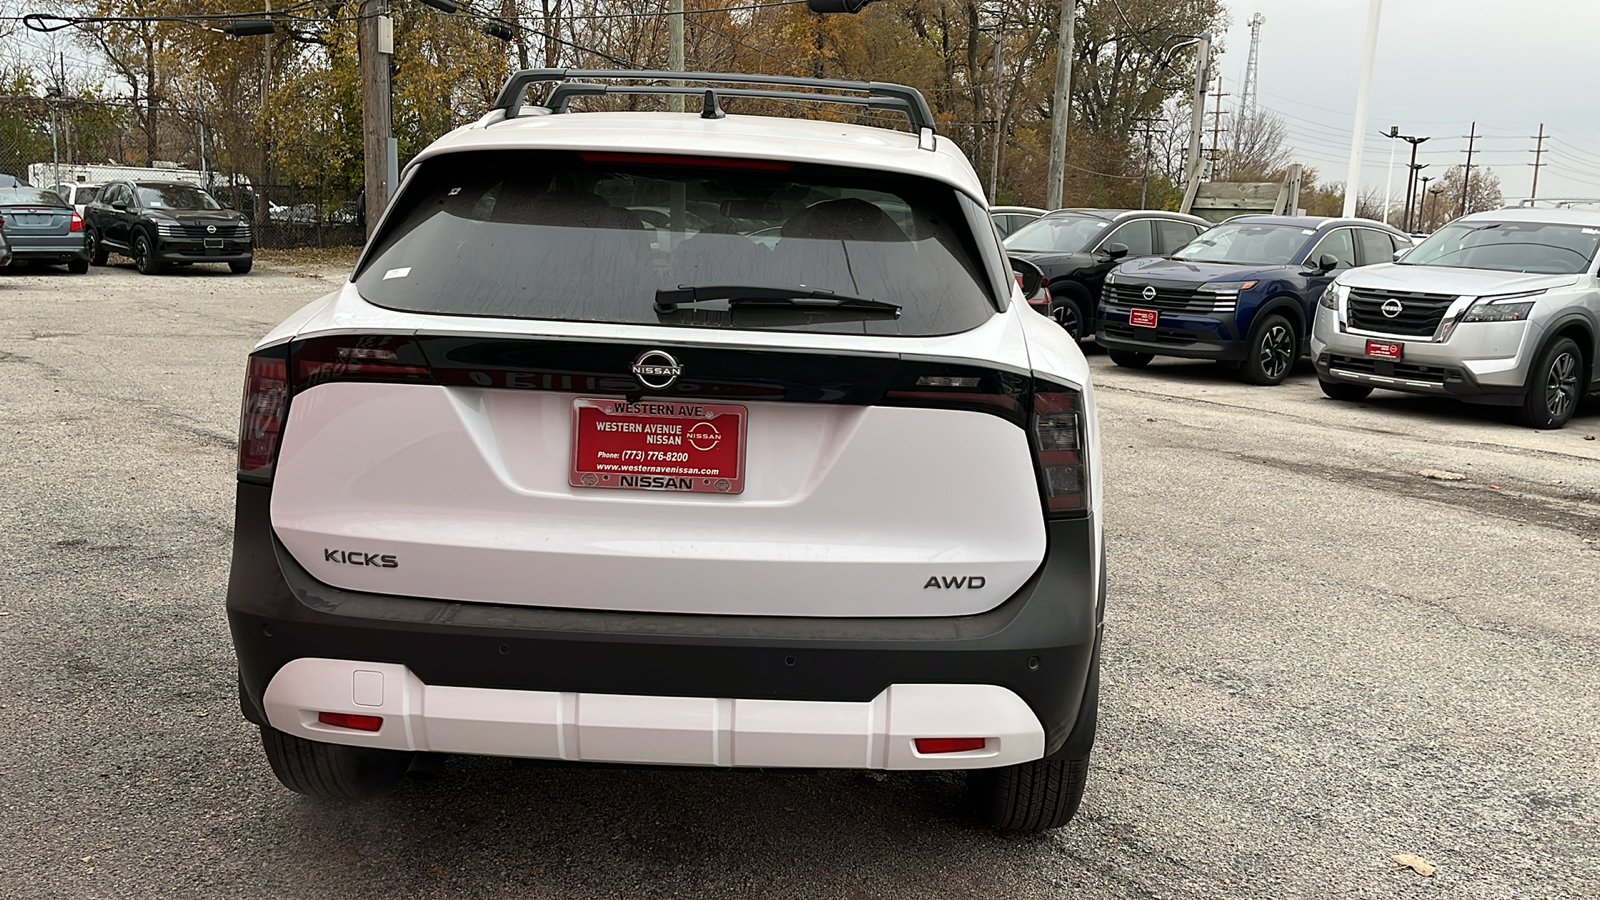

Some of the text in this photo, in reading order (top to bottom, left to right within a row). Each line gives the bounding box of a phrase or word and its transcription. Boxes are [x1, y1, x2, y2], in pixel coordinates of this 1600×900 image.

[632, 366, 681, 376] NISSAN
[614, 402, 706, 417] WESTERN AVE.
[596, 421, 682, 435] WESTERN AVENUE
[646, 435, 682, 445] NISSAN
[686, 433, 721, 441] NISSAN
[598, 450, 689, 462] Phone: (773) 776-8200
[596, 463, 719, 476] www.westernavenissan.com
[620, 476, 693, 490] NISSAN
[324, 548, 399, 569] KICKS
[923, 576, 986, 589] AWD
